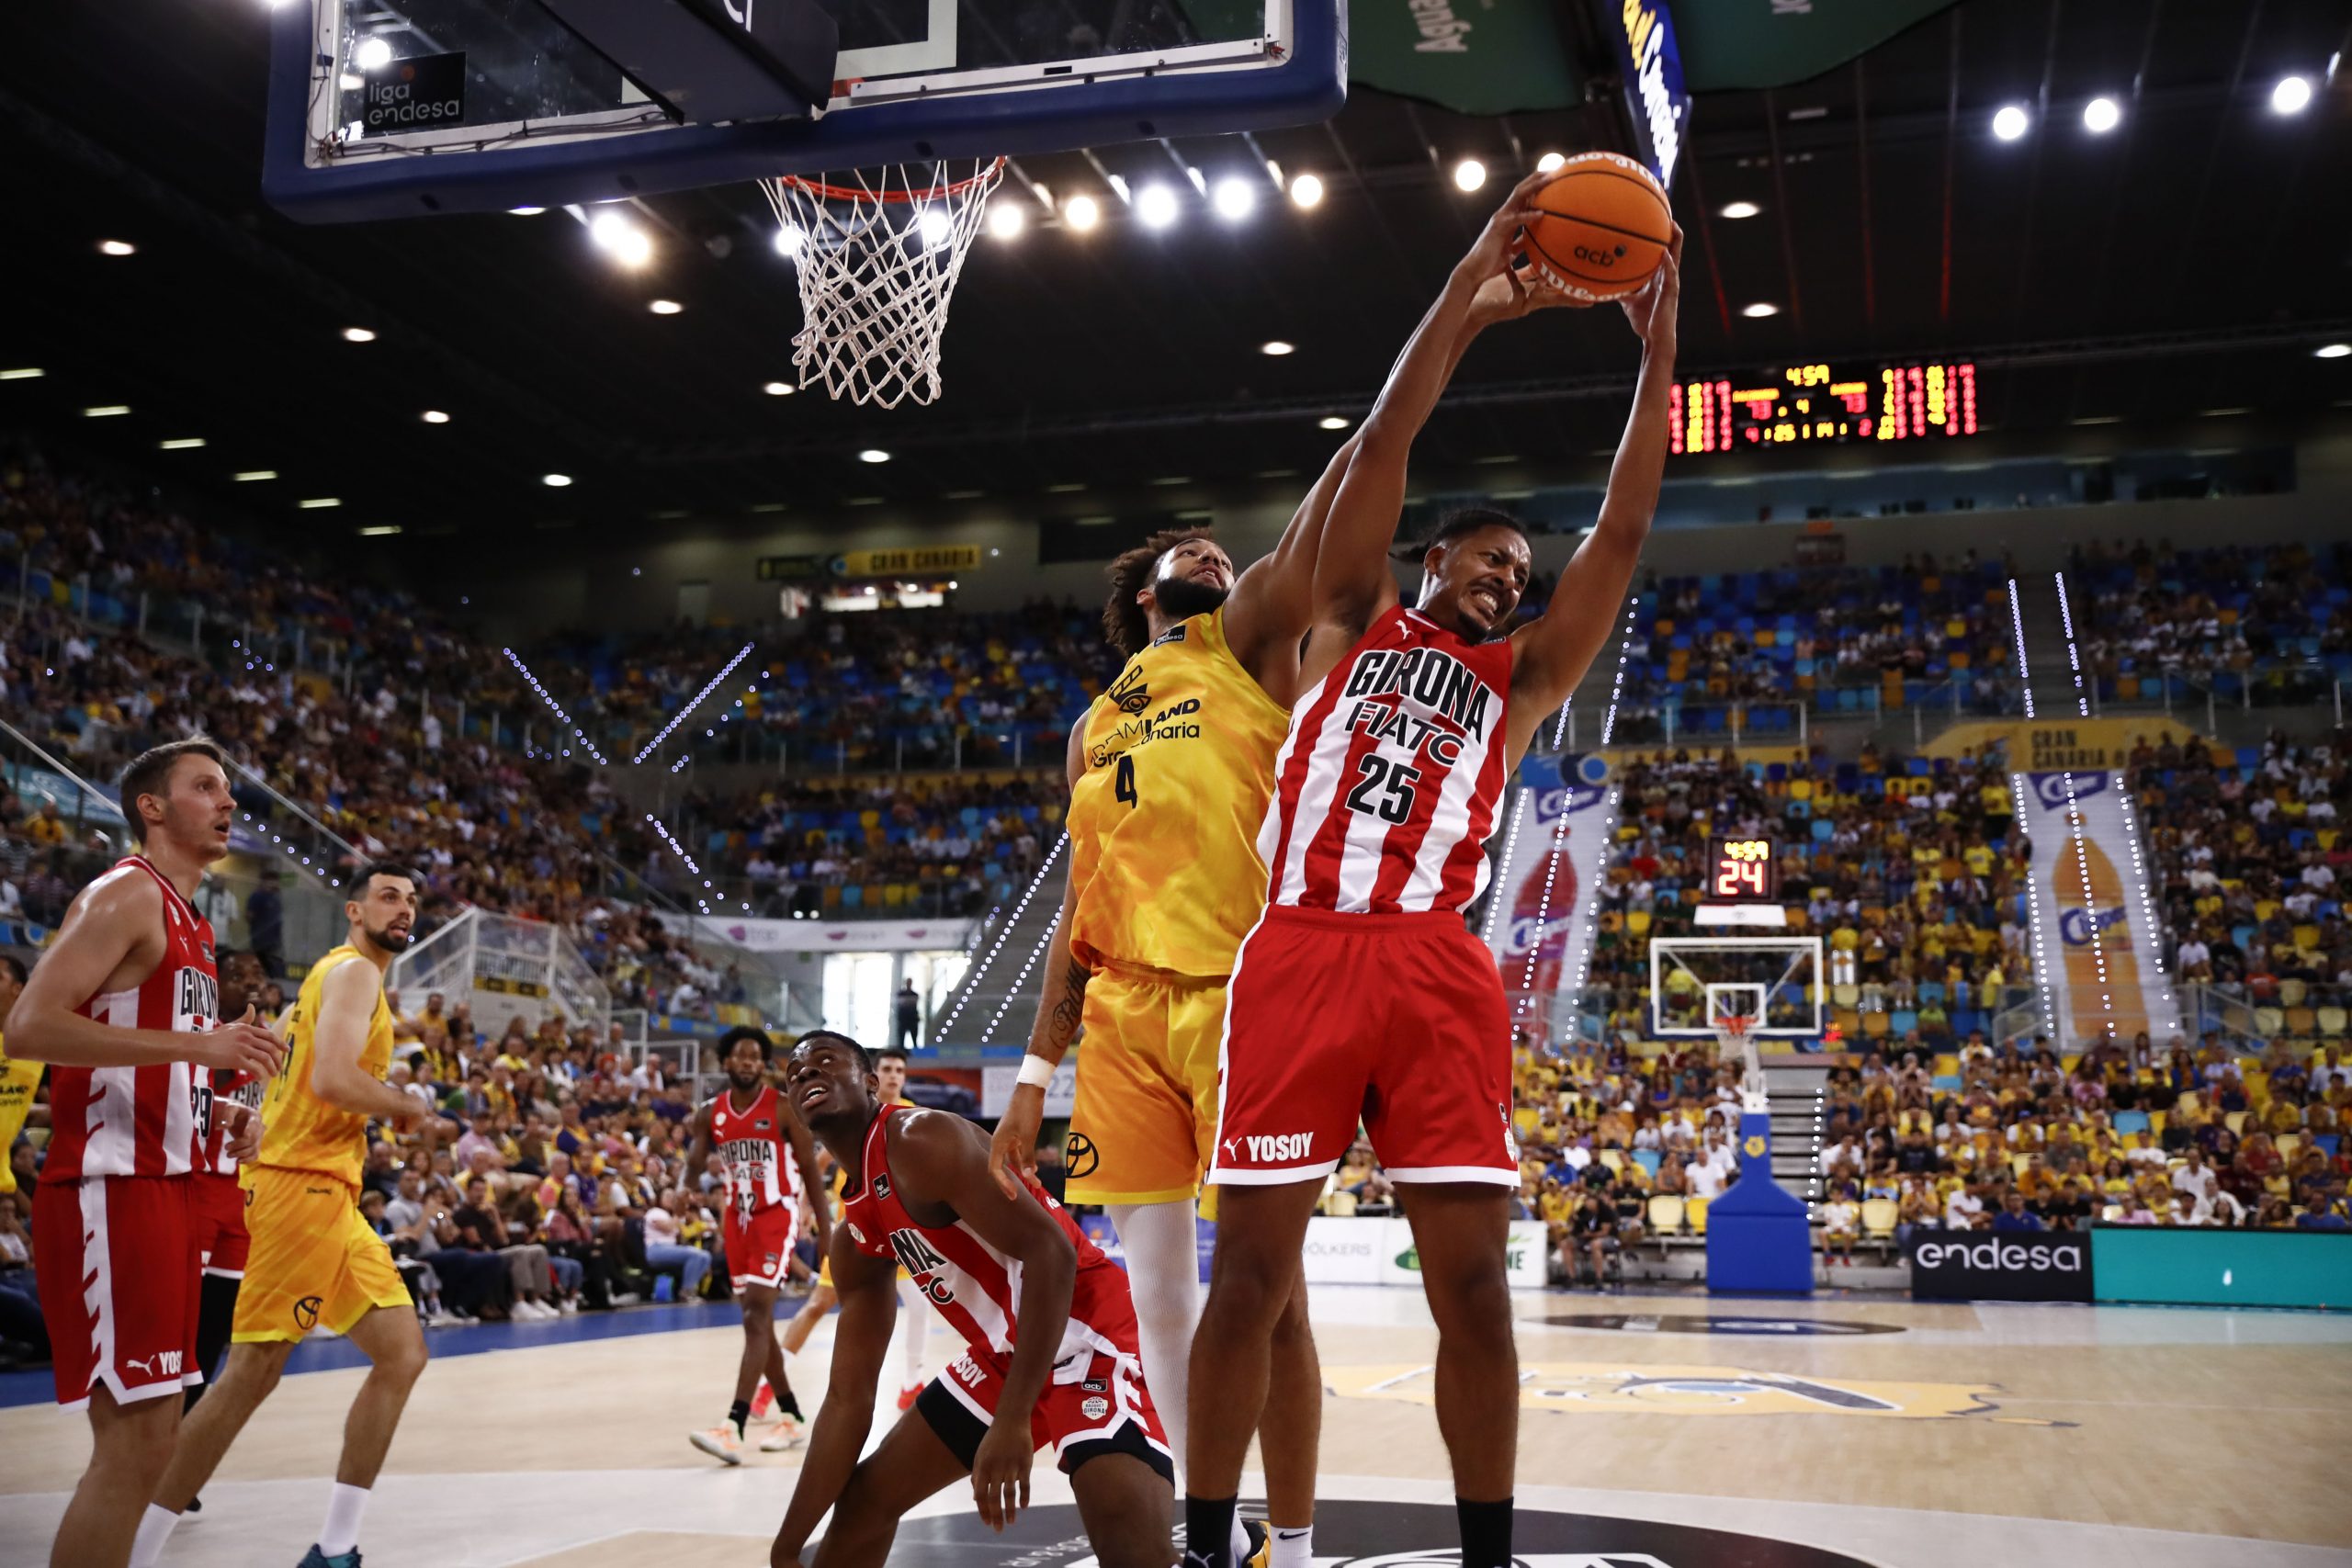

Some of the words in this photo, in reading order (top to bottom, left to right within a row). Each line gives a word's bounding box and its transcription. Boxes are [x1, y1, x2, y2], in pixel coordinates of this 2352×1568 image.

[369, 82, 410, 105] liga
[368, 100, 459, 125] endesa
[1574, 245, 1614, 266] acb
[1344, 646, 1491, 747] GIRONA
[1344, 701, 1465, 768] FIATC
[2031, 729, 2076, 748] GRAN
[2032, 748, 2106, 769] CANARIA
[1114, 755, 1138, 809] 4
[1345, 752, 1422, 827] 25
[1718, 861, 1763, 895] 24
[1246, 1131, 1314, 1162] YOSOY
[1916, 1236, 2082, 1272] endesa
[1084, 1382, 1102, 1391] acb
[1083, 1407, 1105, 1416] GIRONA
